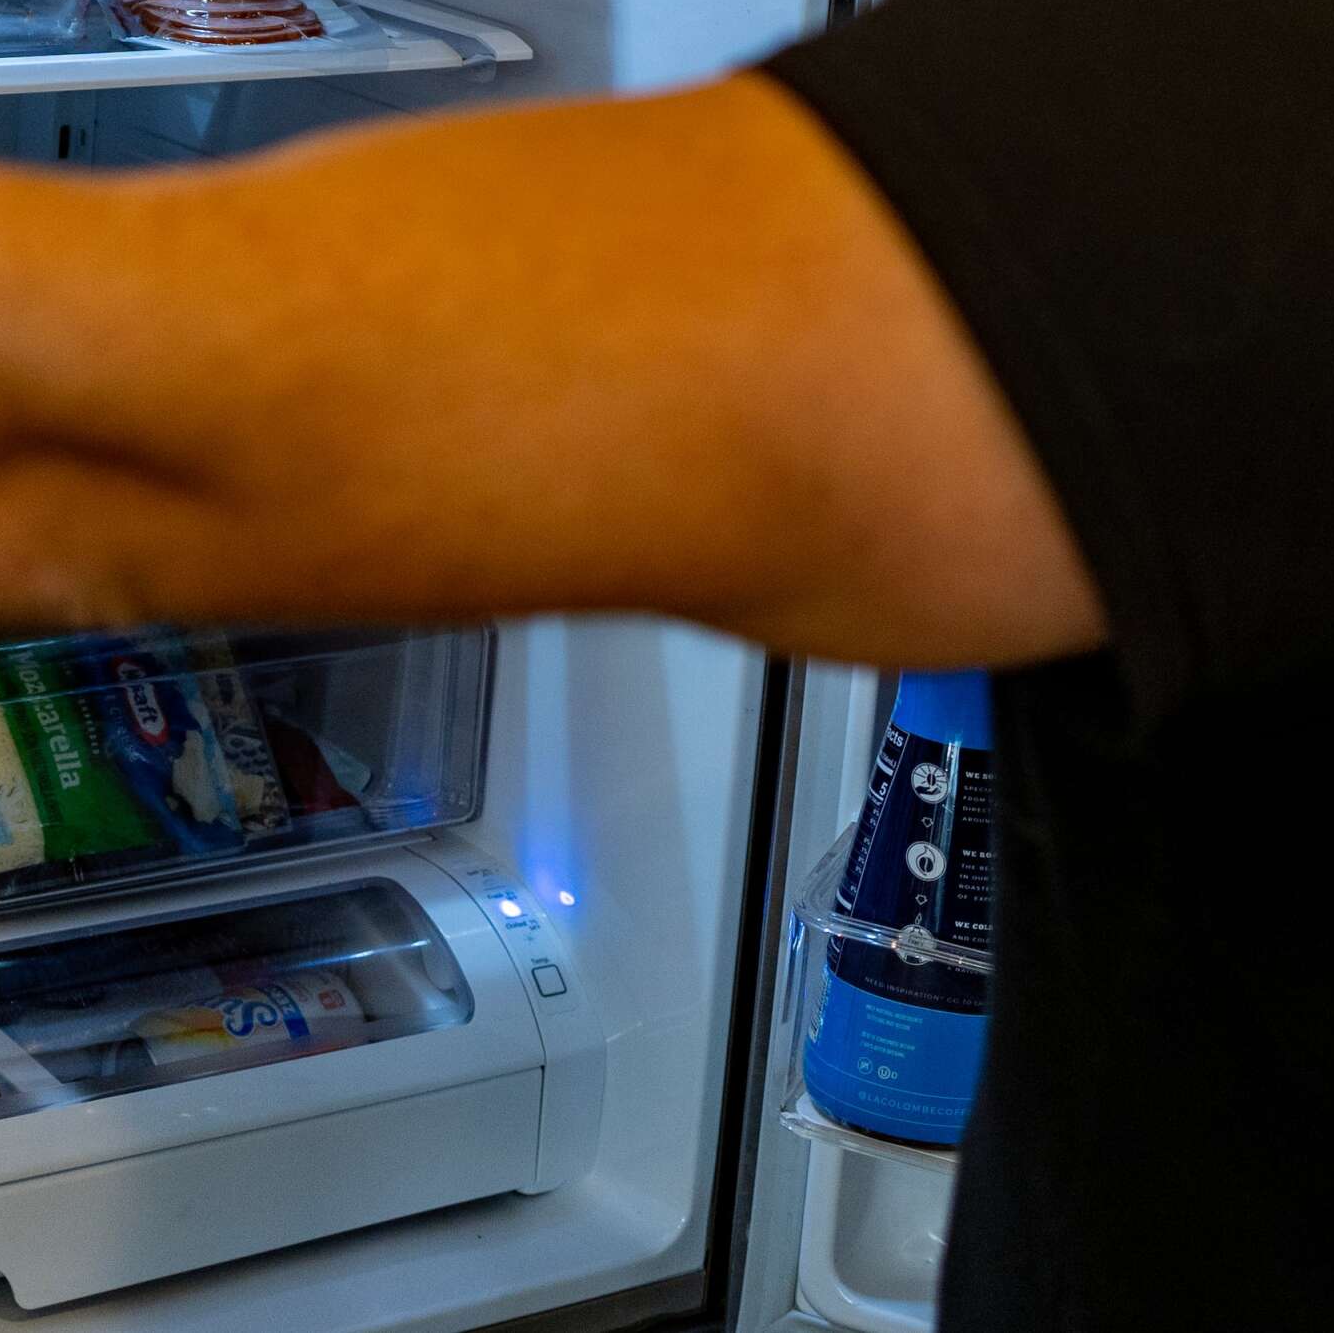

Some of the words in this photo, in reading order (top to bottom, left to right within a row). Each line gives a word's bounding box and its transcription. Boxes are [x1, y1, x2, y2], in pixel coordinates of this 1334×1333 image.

[965, 771, 980, 779] WE
[962, 849, 977, 858] WE
[954, 921, 970, 930] WE
[864, 976, 884, 988] NEED
